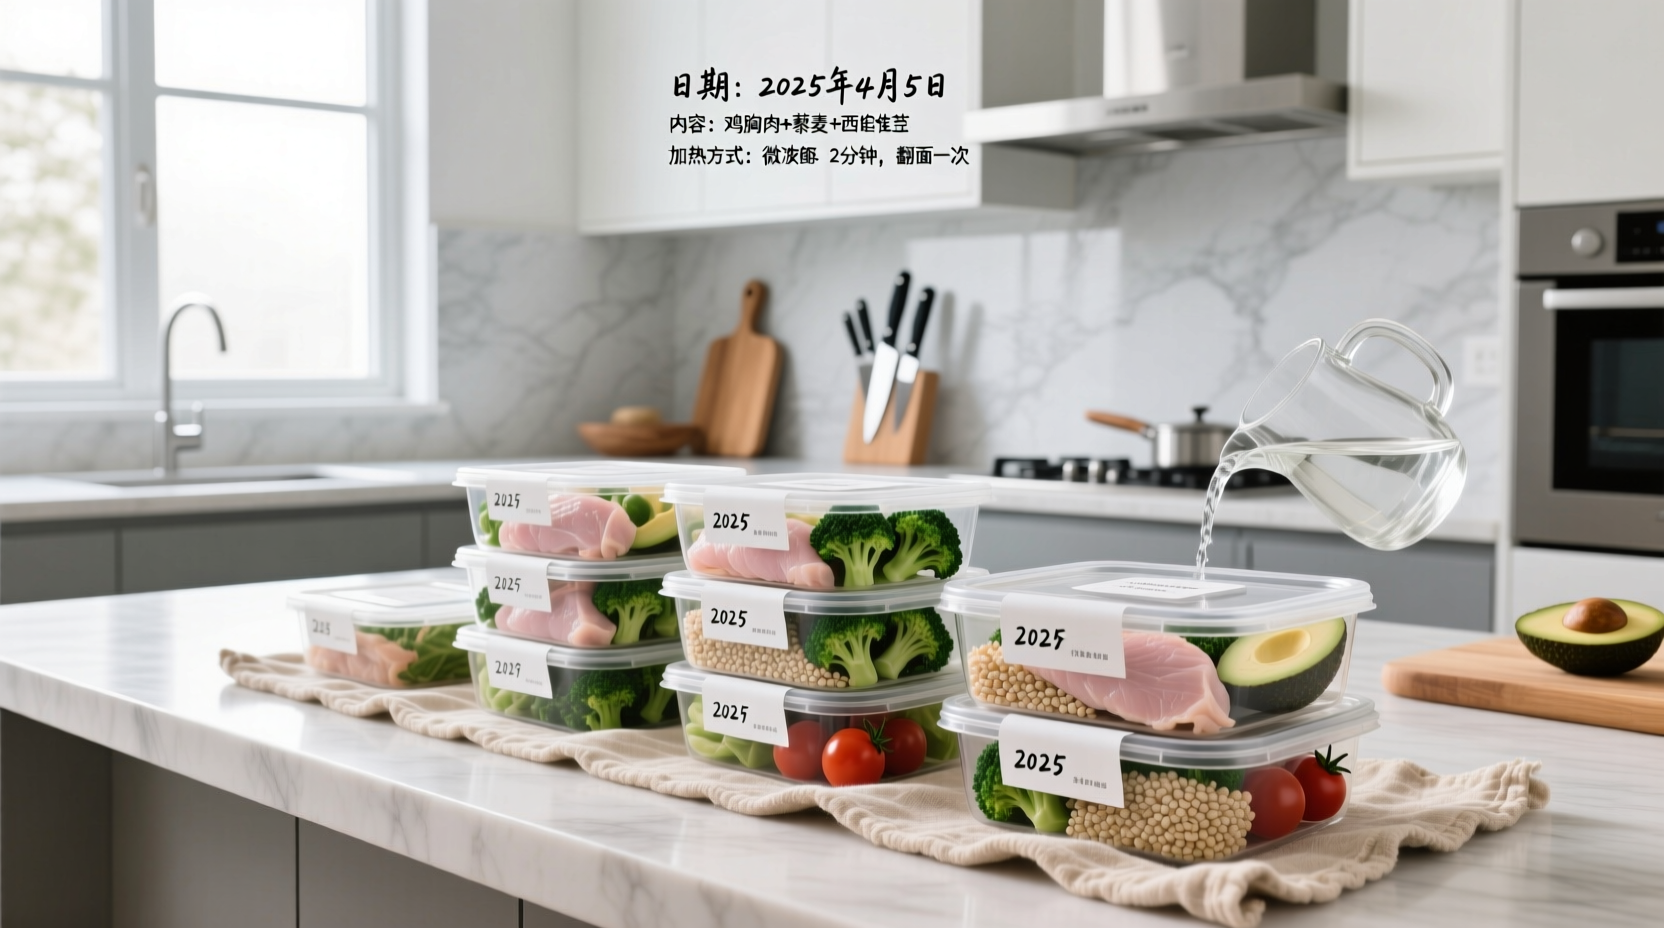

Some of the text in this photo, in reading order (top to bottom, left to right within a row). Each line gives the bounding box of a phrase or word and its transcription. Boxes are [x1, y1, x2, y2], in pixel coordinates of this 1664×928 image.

[712, 512, 750, 531] 2025
[710, 608, 748, 628] 2025
[1014, 626, 1066, 651] 2025
[712, 701, 749, 724] 2025
[1013, 749, 1067, 776] 2025
